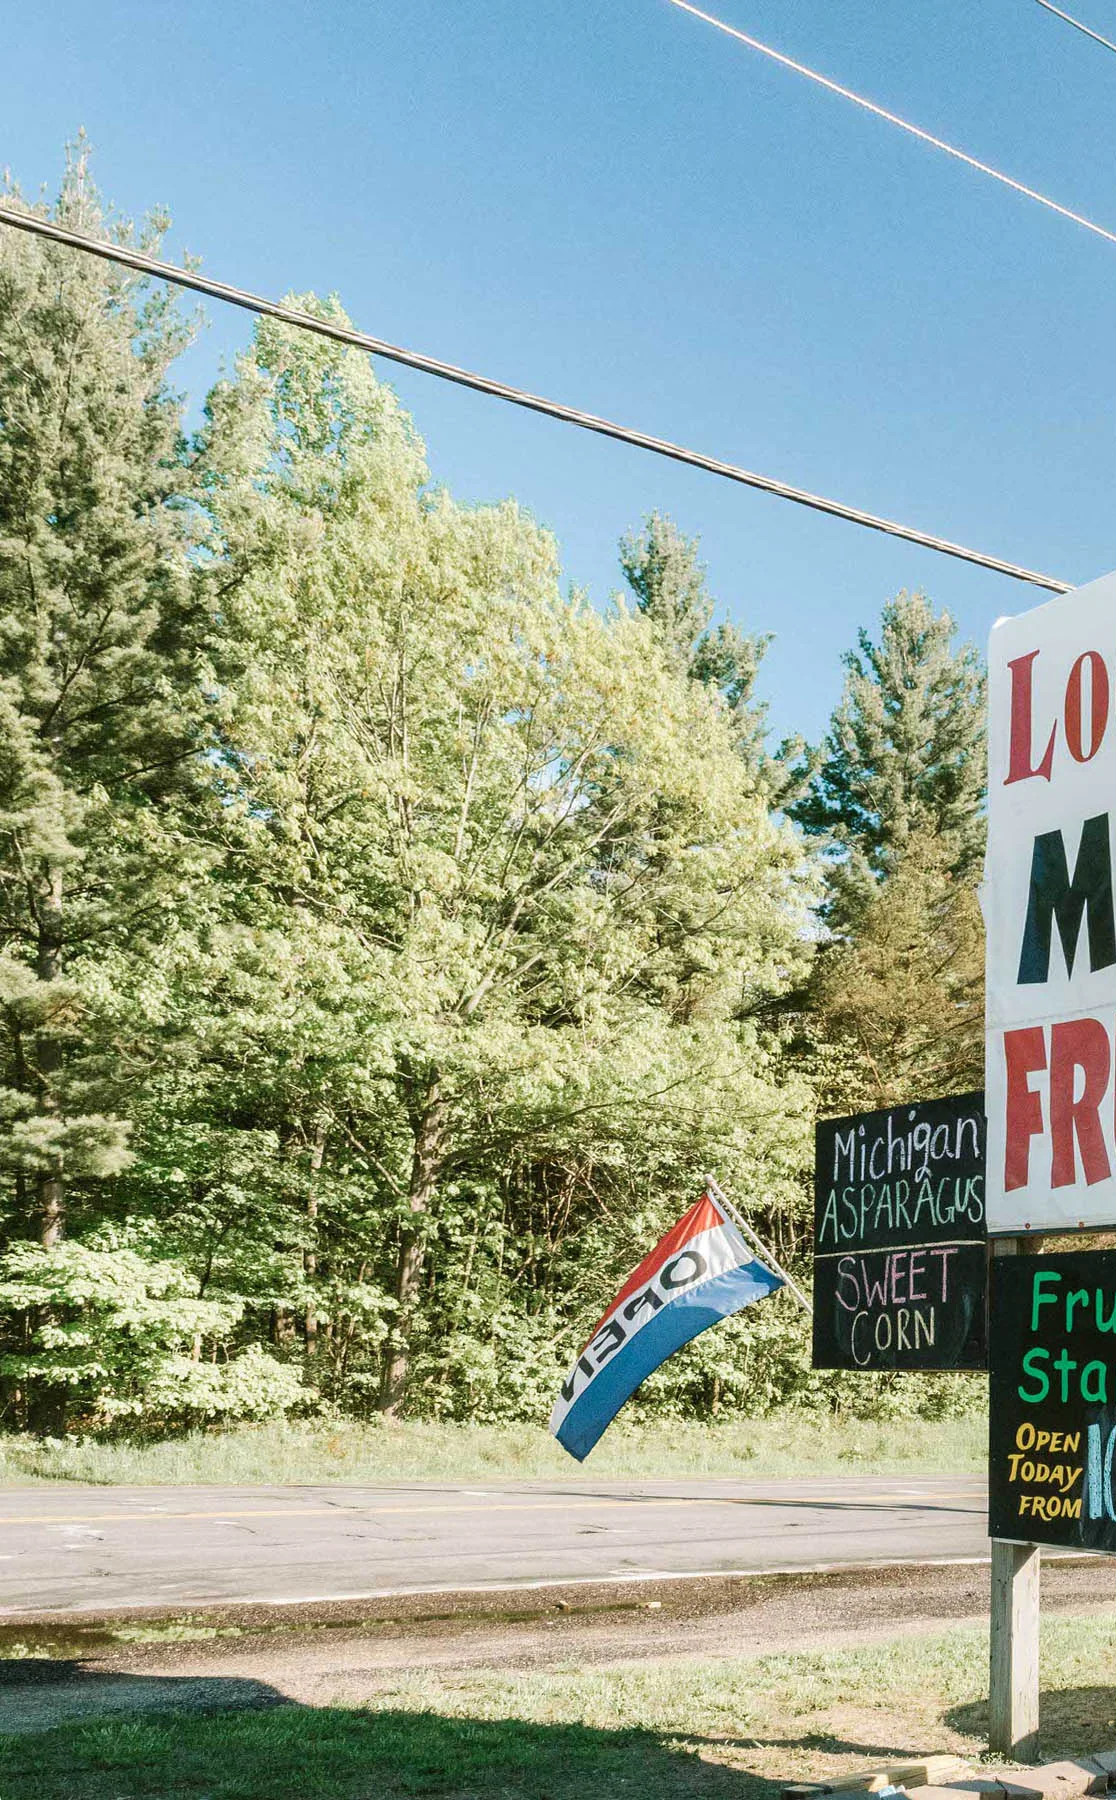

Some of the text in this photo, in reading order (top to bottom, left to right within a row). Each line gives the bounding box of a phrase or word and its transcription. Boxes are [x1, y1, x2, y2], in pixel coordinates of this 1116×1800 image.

[834, 1110, 980, 1182] Michigan
[819, 1175, 983, 1243] ASPARAGUS
[835, 1248, 958, 1311] SWEET
[851, 1306, 935, 1365] CORN
[1015, 1422, 1081, 1454] OPEN
[1007, 1453, 1084, 1494] TODAY
[1018, 1495, 1083, 1522] FROM
